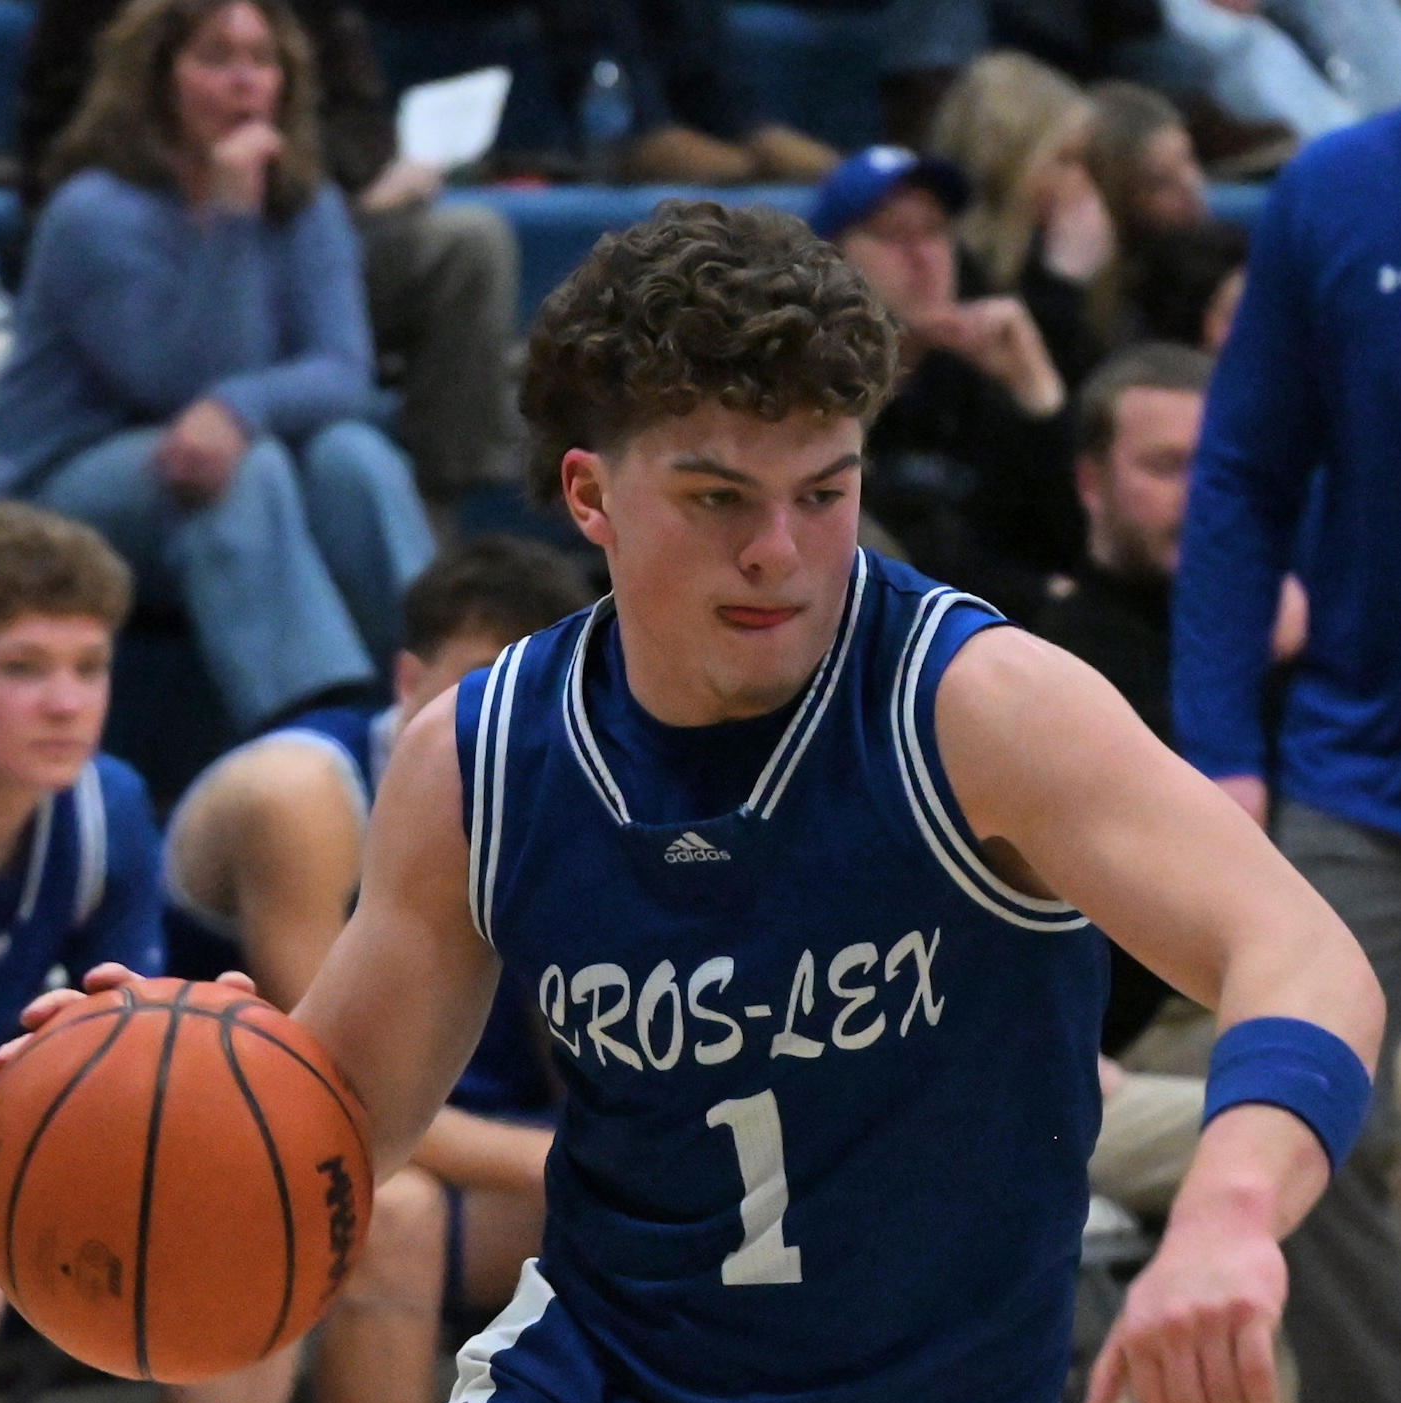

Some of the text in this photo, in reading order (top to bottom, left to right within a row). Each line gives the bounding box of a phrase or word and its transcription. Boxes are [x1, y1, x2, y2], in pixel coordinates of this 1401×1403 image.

[663, 848, 732, 864] adidas
[538, 926, 946, 1072] CROS-LEX
[705, 1087, 803, 1286] 1
